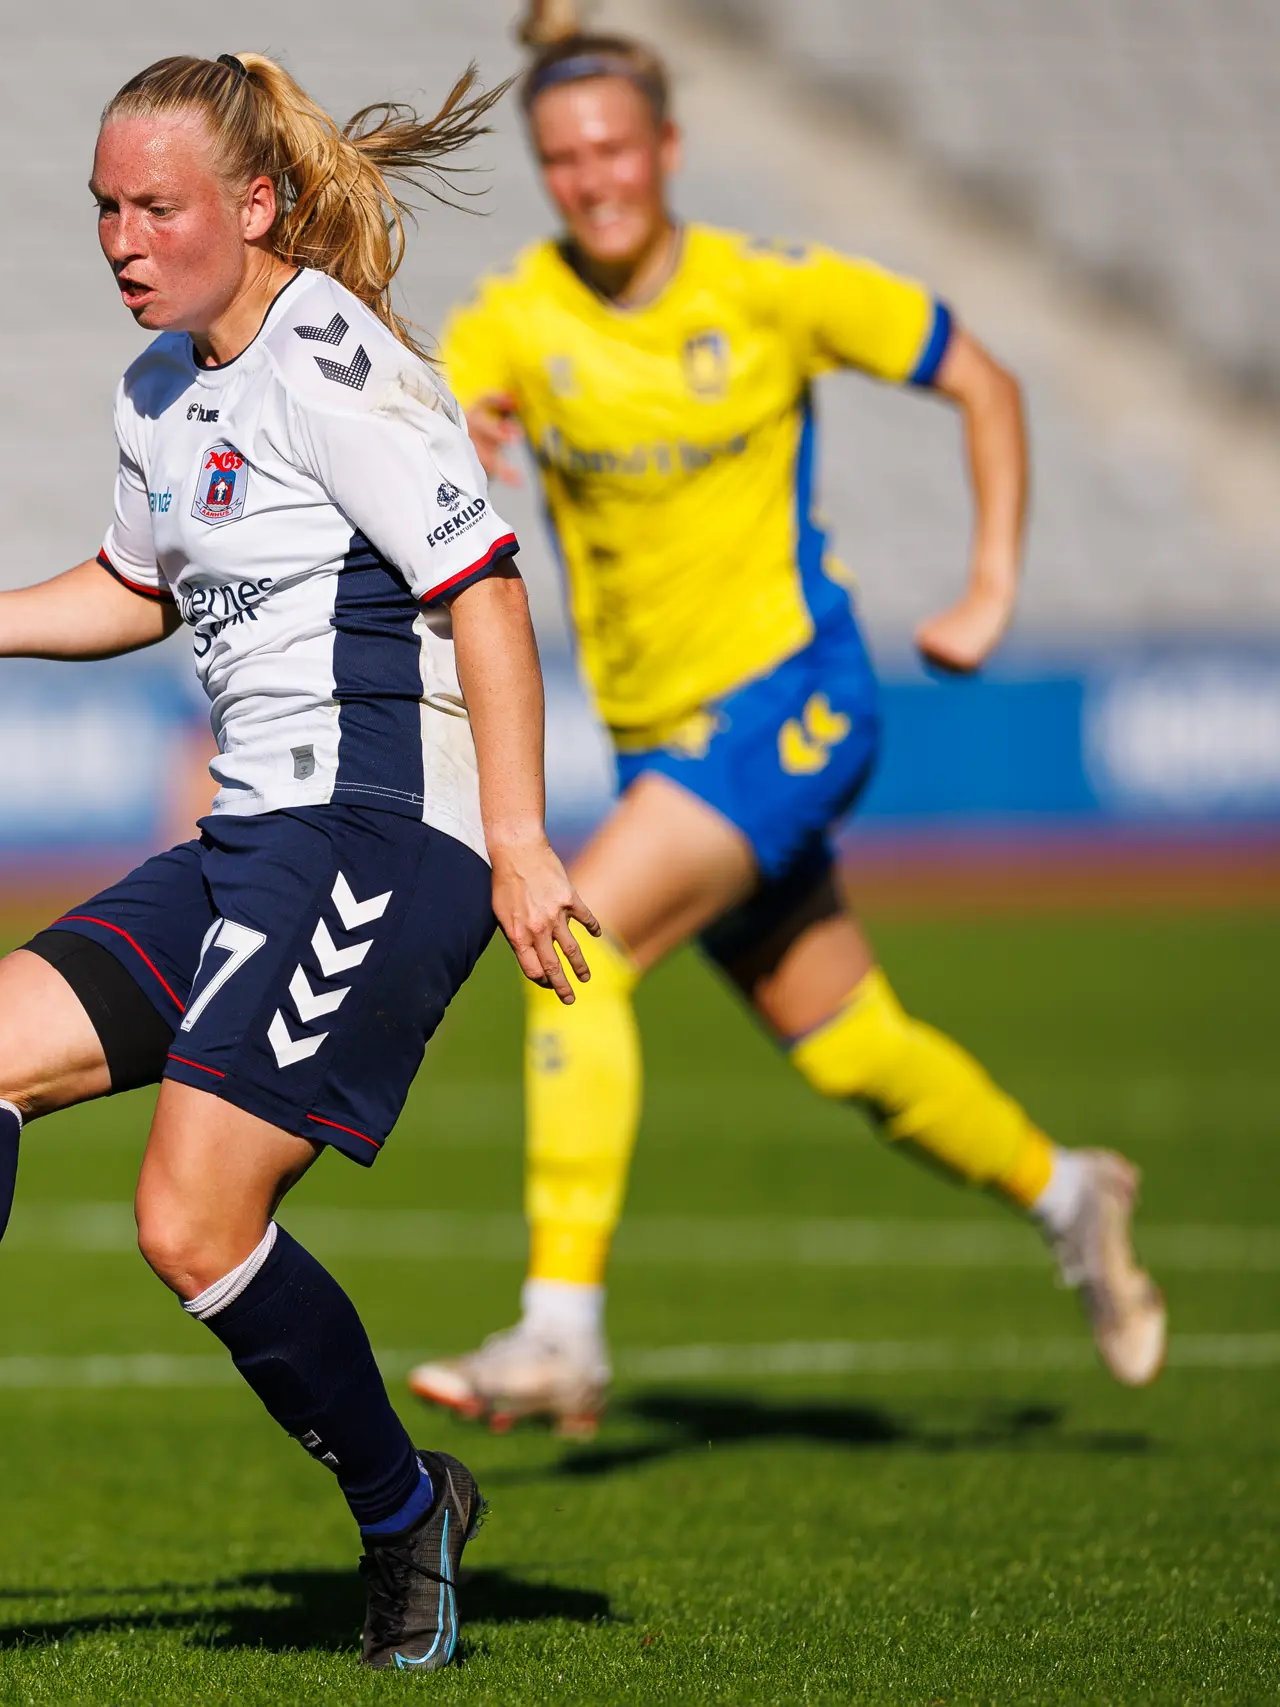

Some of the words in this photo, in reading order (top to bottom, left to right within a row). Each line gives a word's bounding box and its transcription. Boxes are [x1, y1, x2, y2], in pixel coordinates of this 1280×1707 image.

[426, 498, 486, 548] EGEKILD
[443, 536, 455, 546] REN
[455, 511, 488, 538] NATURKRAFT
